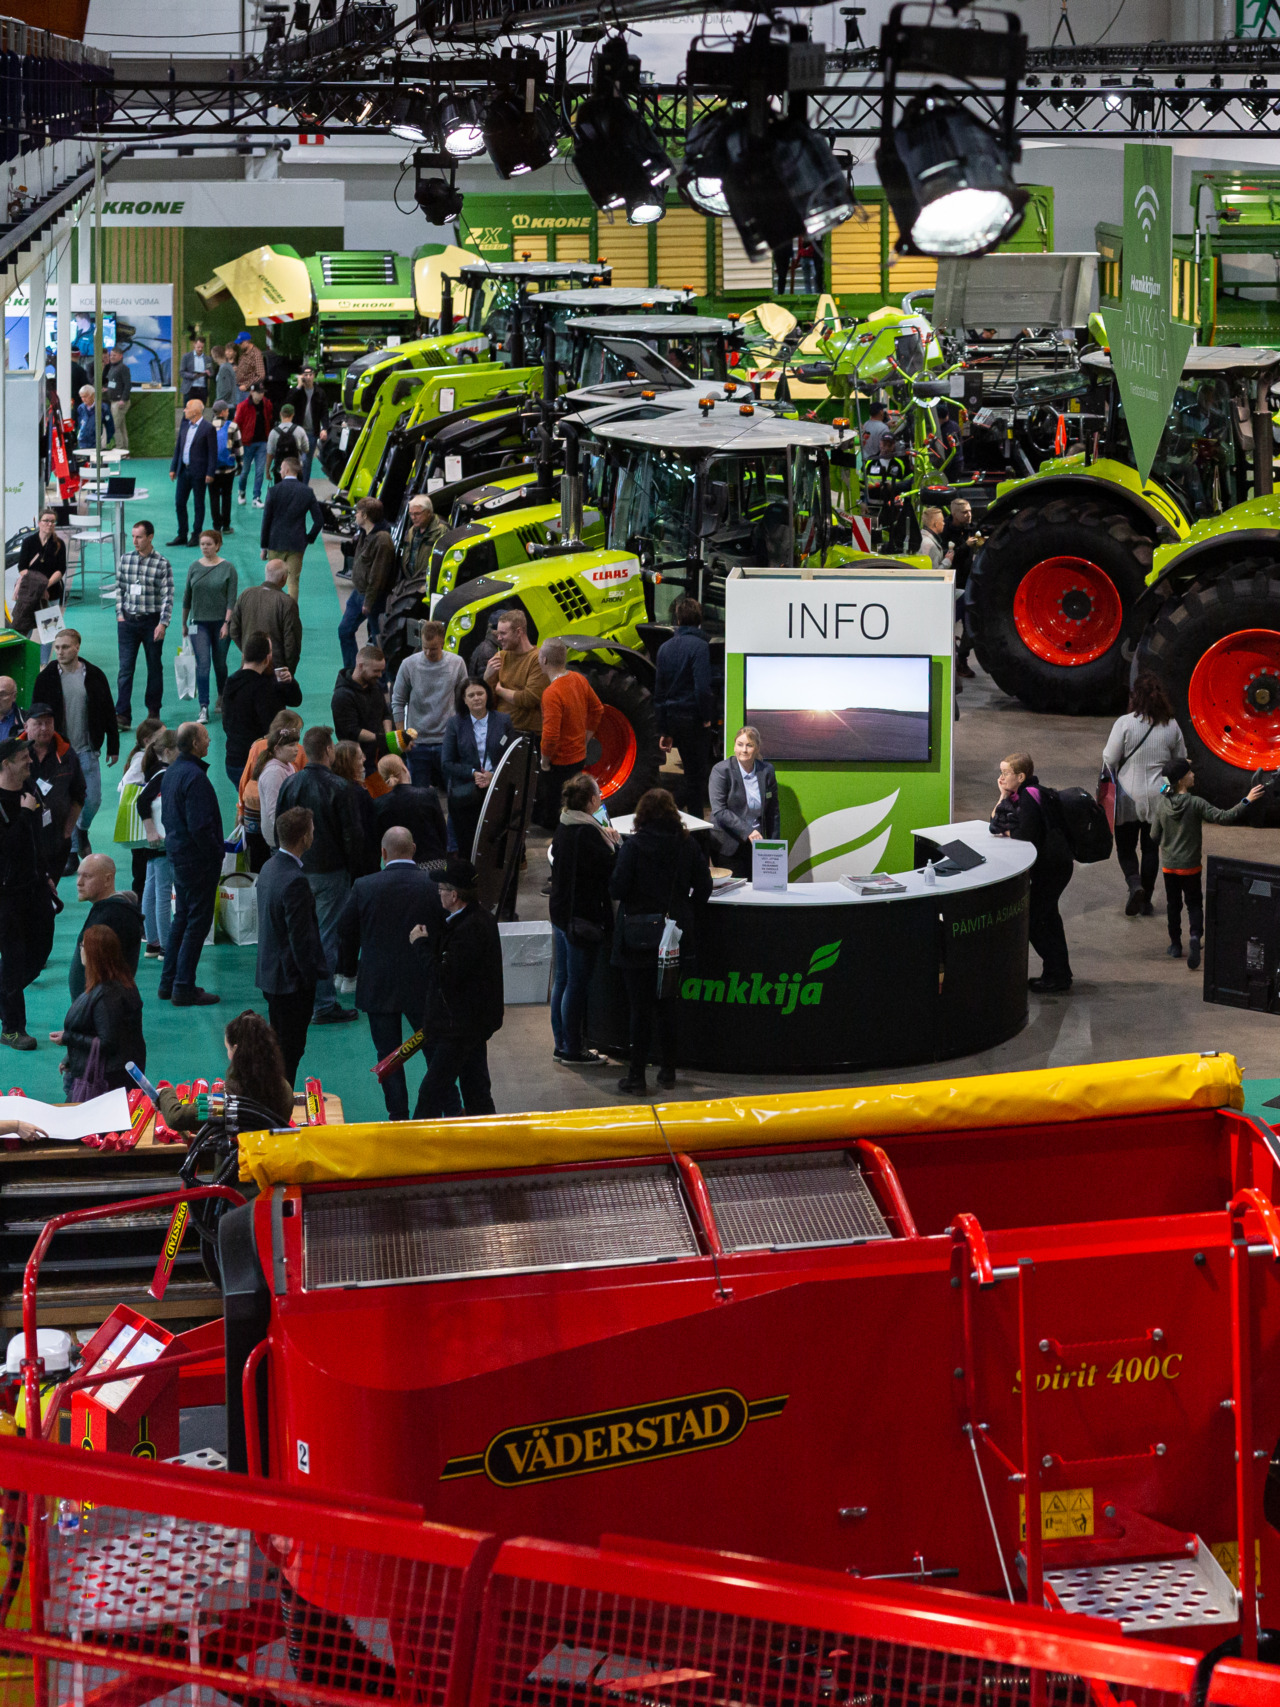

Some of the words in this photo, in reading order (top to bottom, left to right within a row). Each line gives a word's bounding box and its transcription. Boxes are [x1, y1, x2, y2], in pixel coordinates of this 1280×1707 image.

[101, 201, 185, 215] KRONE
[465, 227, 503, 245] ZX
[530, 216, 592, 229] KRONE
[1124, 297, 1167, 341] ÄLYKÄS
[1121, 338, 1169, 381] MAATILA
[592, 568, 629, 582] CLAAS
[601, 596, 623, 604] ARION
[788, 602, 890, 641] INFO
[679, 970, 824, 1015] ankkija
[1106, 1353, 1183, 1385] 400C
[504, 1402, 731, 1475] VÄDERSTAD
[299, 1443, 308, 1467] 2
